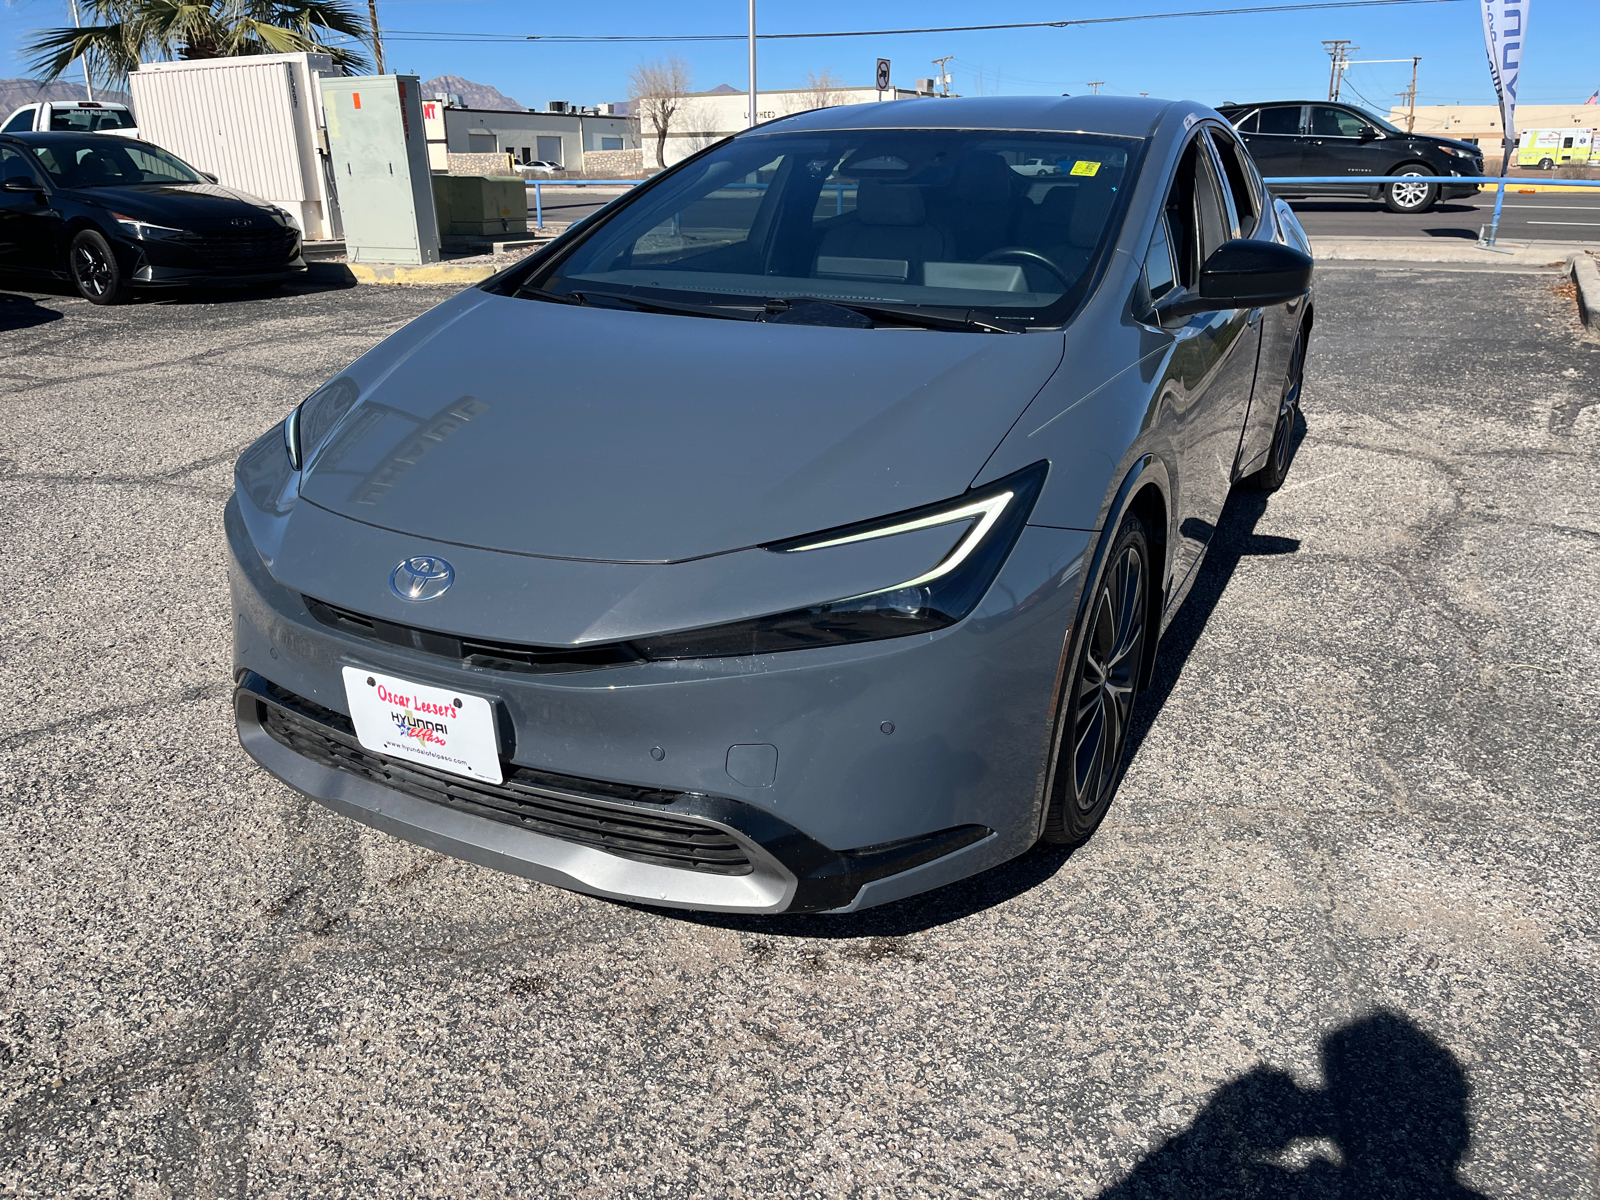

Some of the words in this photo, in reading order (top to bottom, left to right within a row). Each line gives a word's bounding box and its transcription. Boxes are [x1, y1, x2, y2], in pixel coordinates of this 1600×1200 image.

[377, 684, 410, 708] Oscar
[414, 696, 457, 719] Leeser's
[391, 711, 449, 735] HYUNDAI
